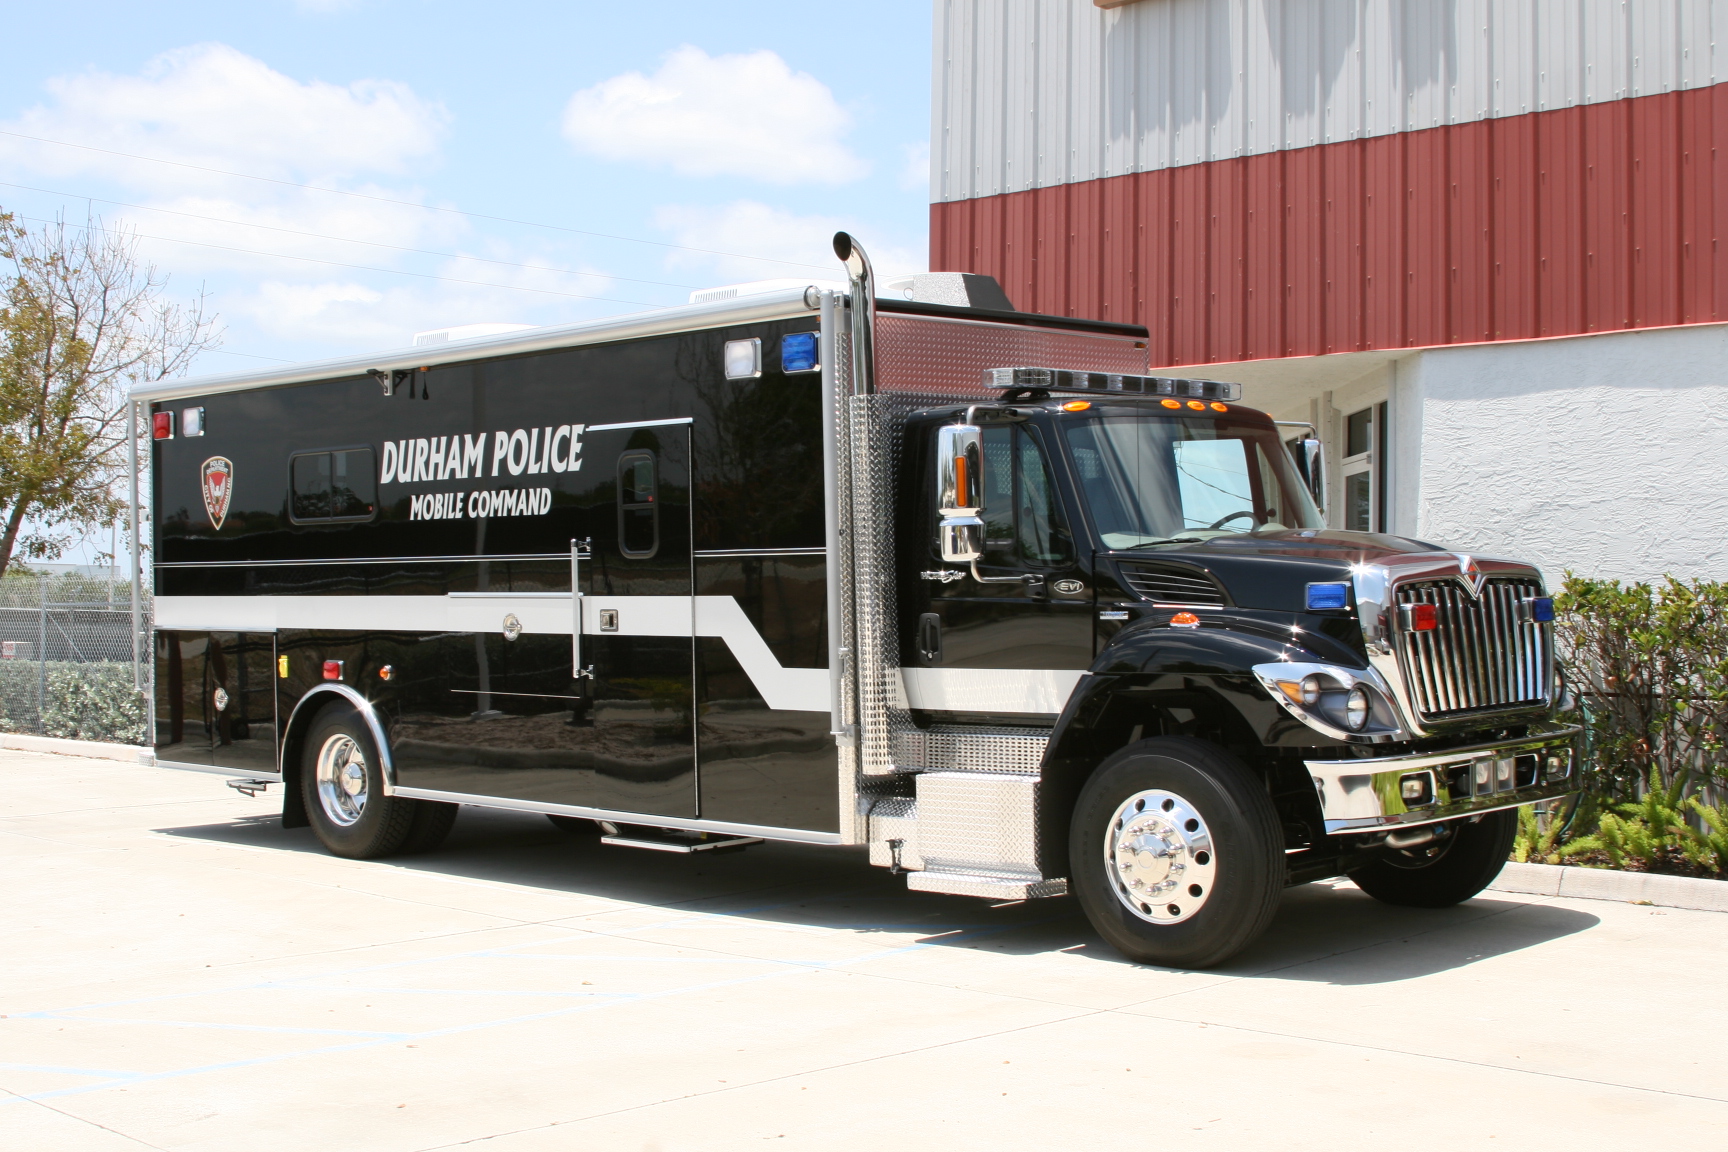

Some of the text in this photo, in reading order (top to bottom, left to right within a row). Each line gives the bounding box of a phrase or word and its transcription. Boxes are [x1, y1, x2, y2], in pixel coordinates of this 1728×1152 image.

[381, 424, 585, 484] DURHAM POLICE
[409, 487, 552, 521] MOBILE COMMAND
[1060, 582, 1080, 591] EVI
